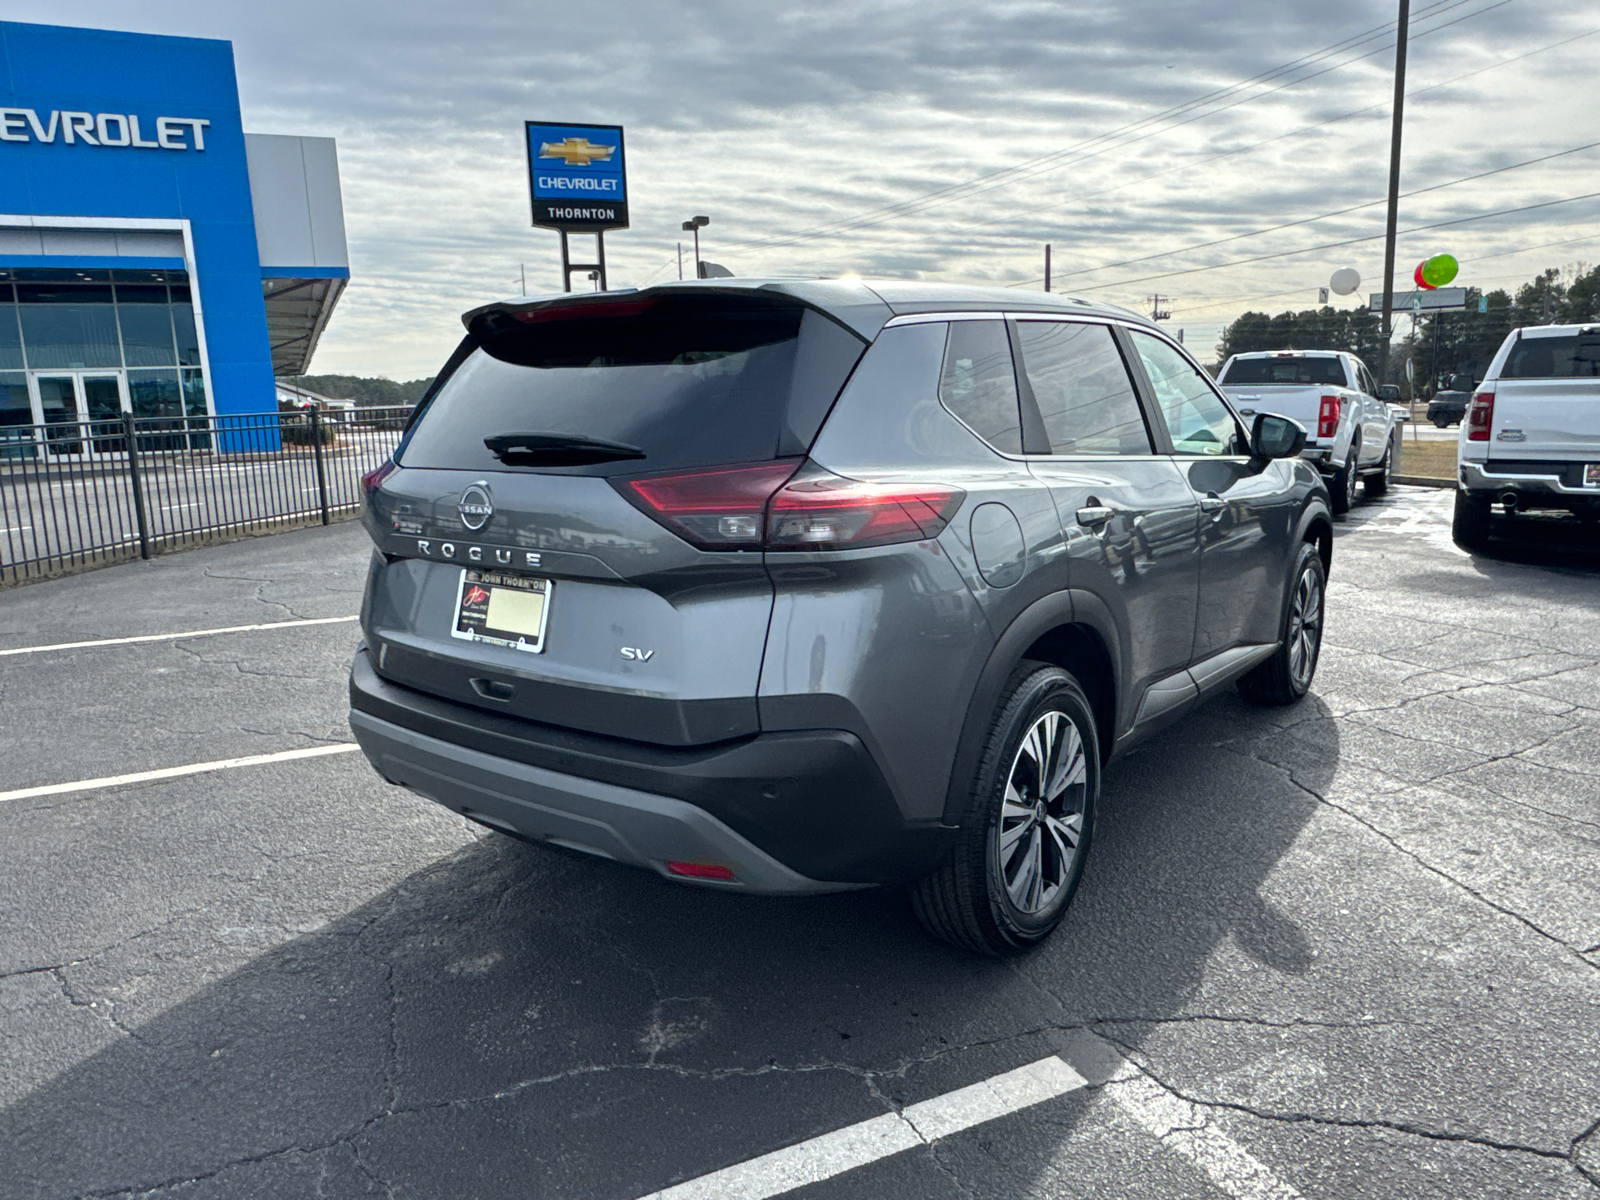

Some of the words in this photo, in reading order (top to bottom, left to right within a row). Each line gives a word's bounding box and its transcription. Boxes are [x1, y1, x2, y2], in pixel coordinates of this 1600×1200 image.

[0, 107, 210, 151] EVROLET
[538, 176, 618, 191] CHEVROLET
[548, 207, 615, 220] THORNTON
[457, 504, 493, 515] NISSAN
[417, 540, 542, 567] ROGUE
[481, 573, 502, 584] JOHN
[620, 646, 655, 662] SV
